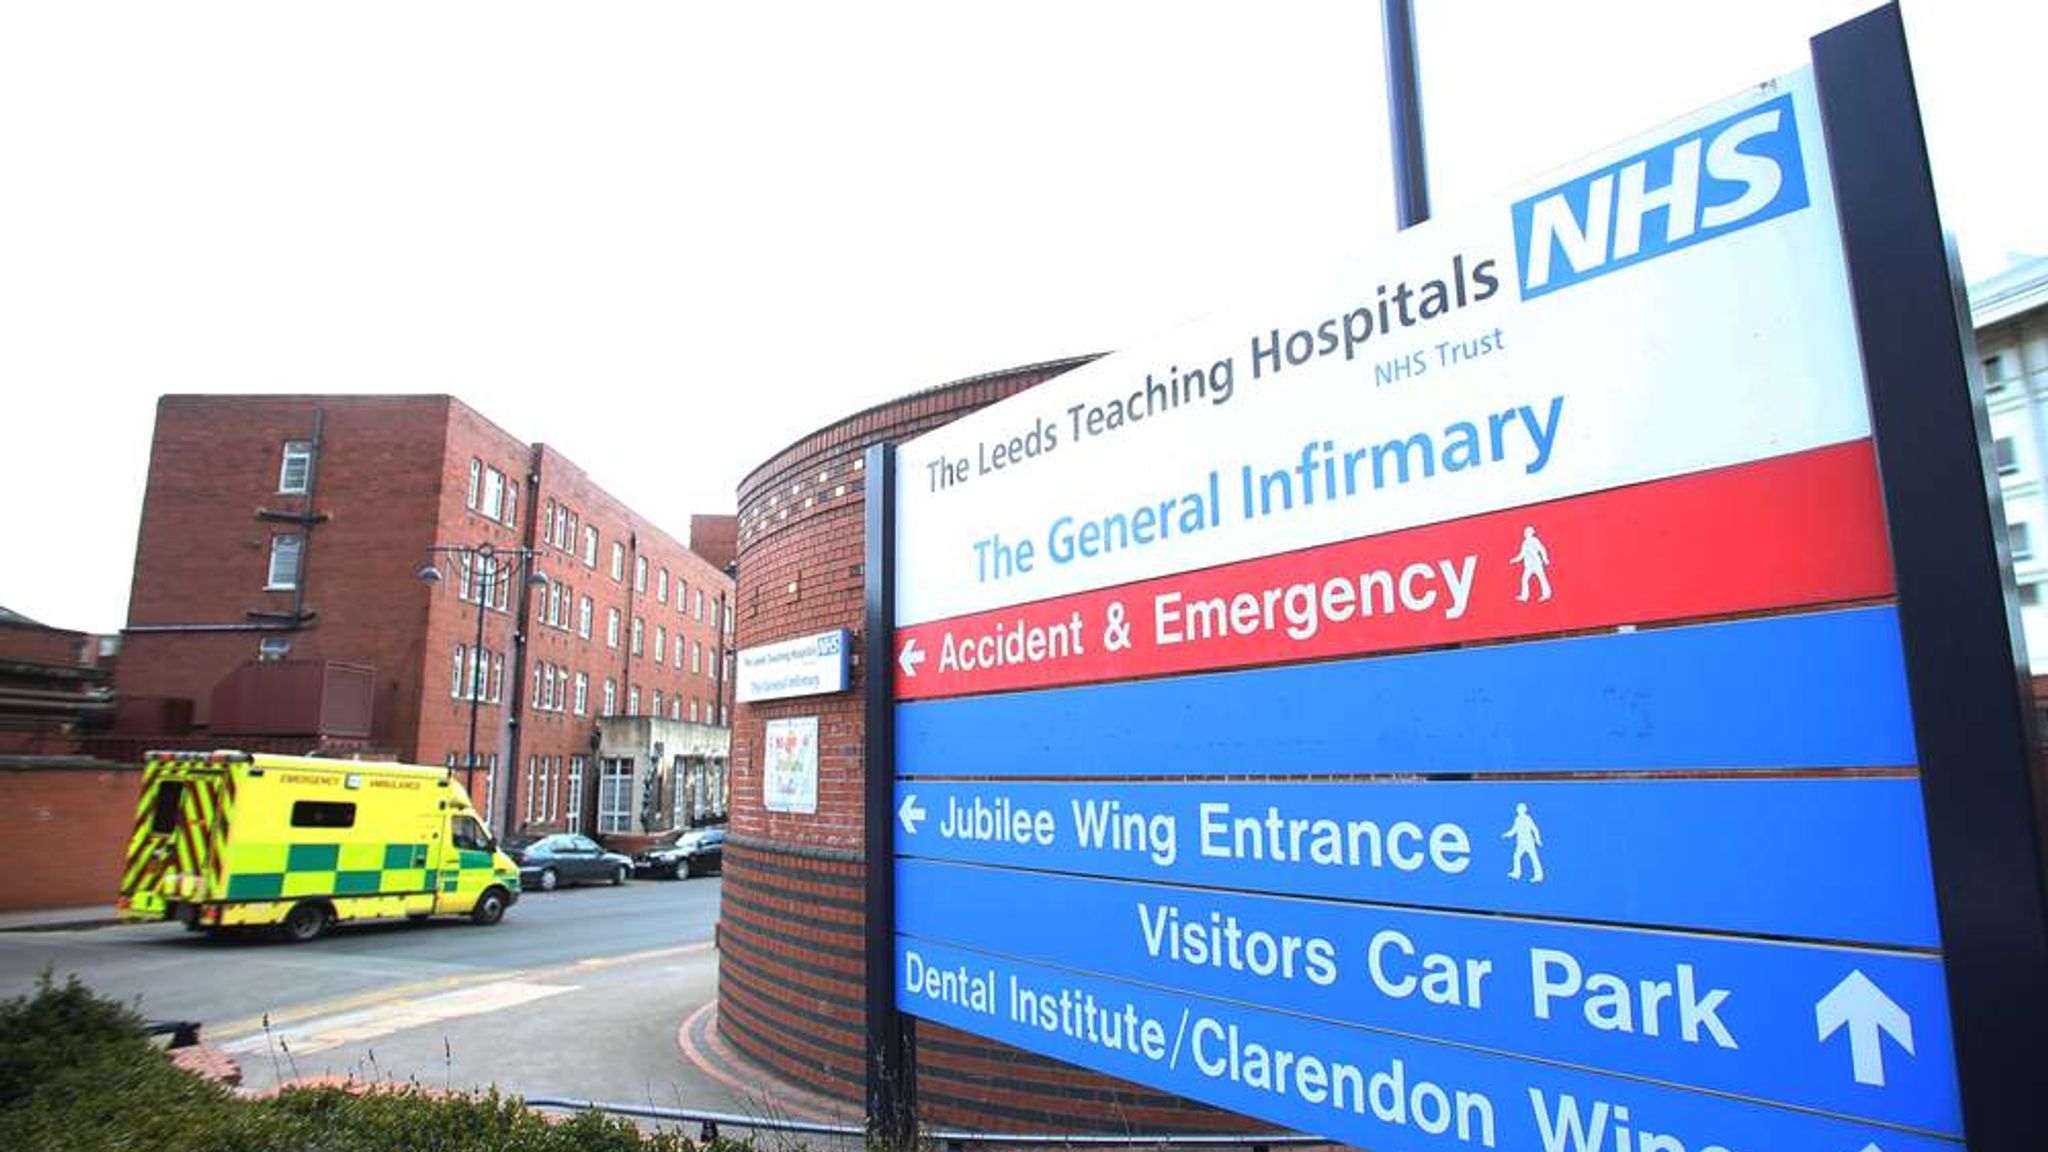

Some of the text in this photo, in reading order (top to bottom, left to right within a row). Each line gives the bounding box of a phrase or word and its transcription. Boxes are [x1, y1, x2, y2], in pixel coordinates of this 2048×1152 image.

[1526, 109, 1782, 290] NHS
[926, 253, 1501, 493] The Leeds Teaching Hospitals
[1375, 327, 1505, 387] NHS Trust
[972, 394, 1565, 583] The General Infirmary
[938, 555, 1478, 673] Accident & Emergency
[279, 773, 421, 790] EMERGENCY AMBULANCE
[940, 797, 1470, 873] Jubilee Wing Entrance
[1138, 903, 1739, 1048] Visitors Car Park
[907, 952, 996, 1015] Dental
[1010, 976, 1495, 1148] Institute/Clarendon
